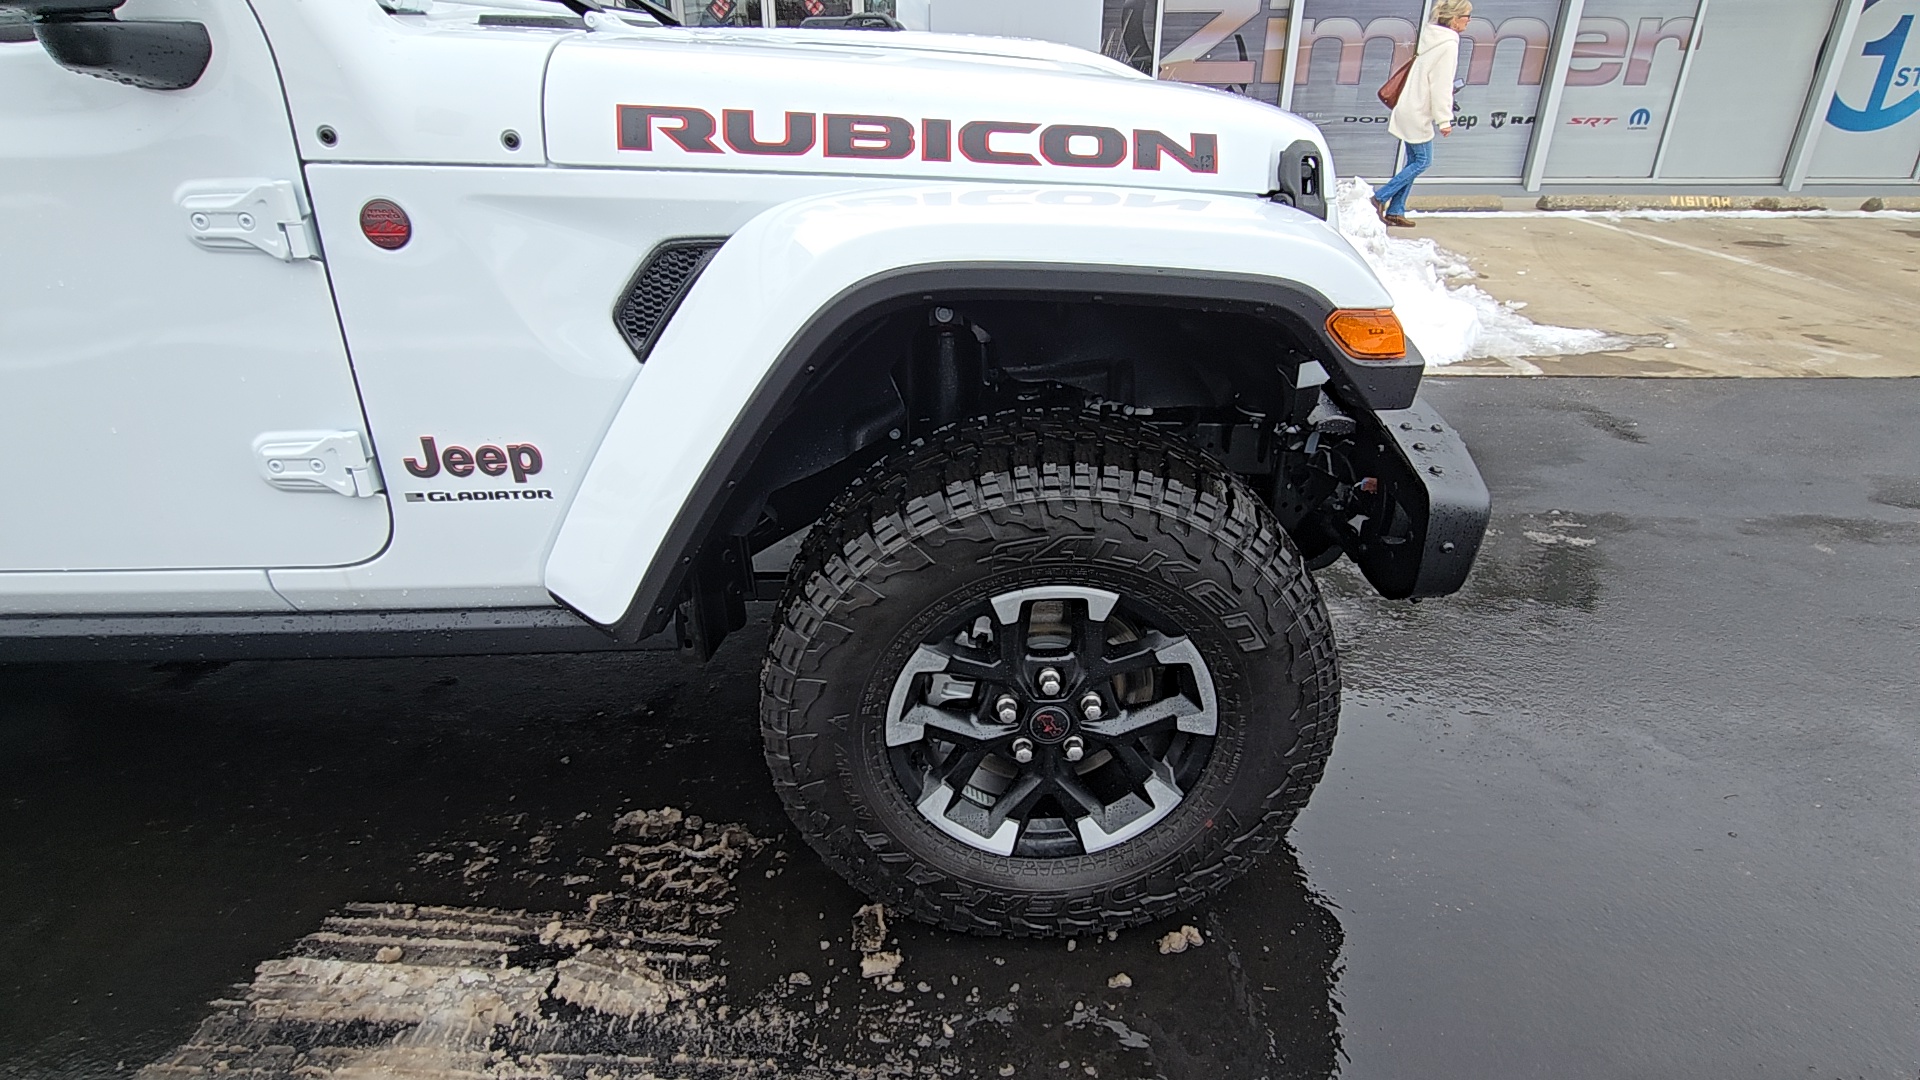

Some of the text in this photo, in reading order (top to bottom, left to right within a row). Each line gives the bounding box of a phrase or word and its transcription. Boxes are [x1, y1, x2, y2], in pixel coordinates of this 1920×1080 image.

[1157, 0, 1703, 86] Zimmer
[616, 103, 1219, 174] RUBICON
[1343, 114, 1618, 130] DOD eep RA SRT
[1670, 195, 1731, 208] VISITOR
[403, 436, 543, 484] Jeep
[426, 489, 554, 502] GLADIATOR
[977, 533, 1268, 653] FALKEN
